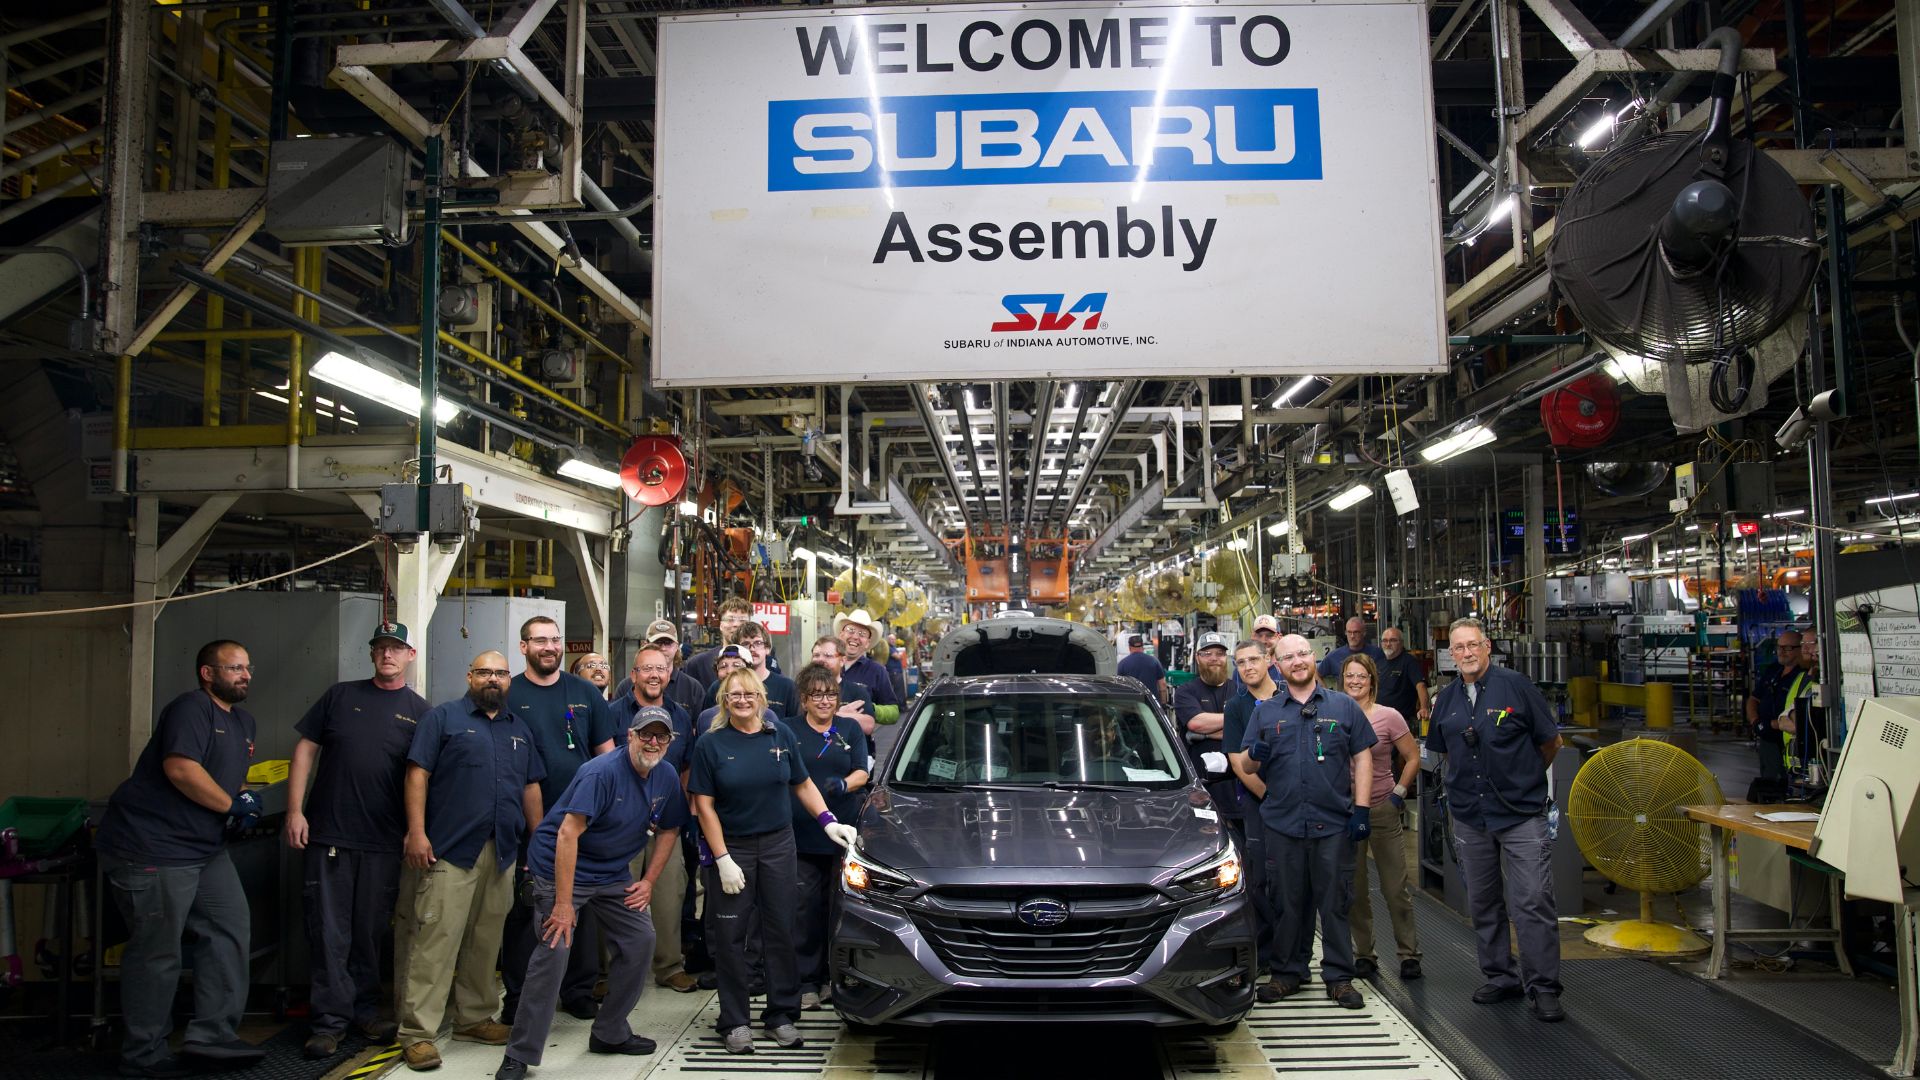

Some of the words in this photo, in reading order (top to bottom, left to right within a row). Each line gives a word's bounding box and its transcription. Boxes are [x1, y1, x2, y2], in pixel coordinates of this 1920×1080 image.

[796, 17, 1171, 77] WELCOME
[1193, 15, 1291, 68] TO
[791, 105, 1297, 175] SUBARU
[873, 205, 1218, 271] Assembly
[944, 339, 991, 349] SUBARU
[994, 339, 1006, 348] of
[1007, 338, 1053, 348] INDIANA
[1056, 336, 1133, 347] AUTOMOTIVE,
[1136, 336, 1158, 345] INC.
[755, 603, 786, 615] PILL
[572, 643, 591, 651] DAN
